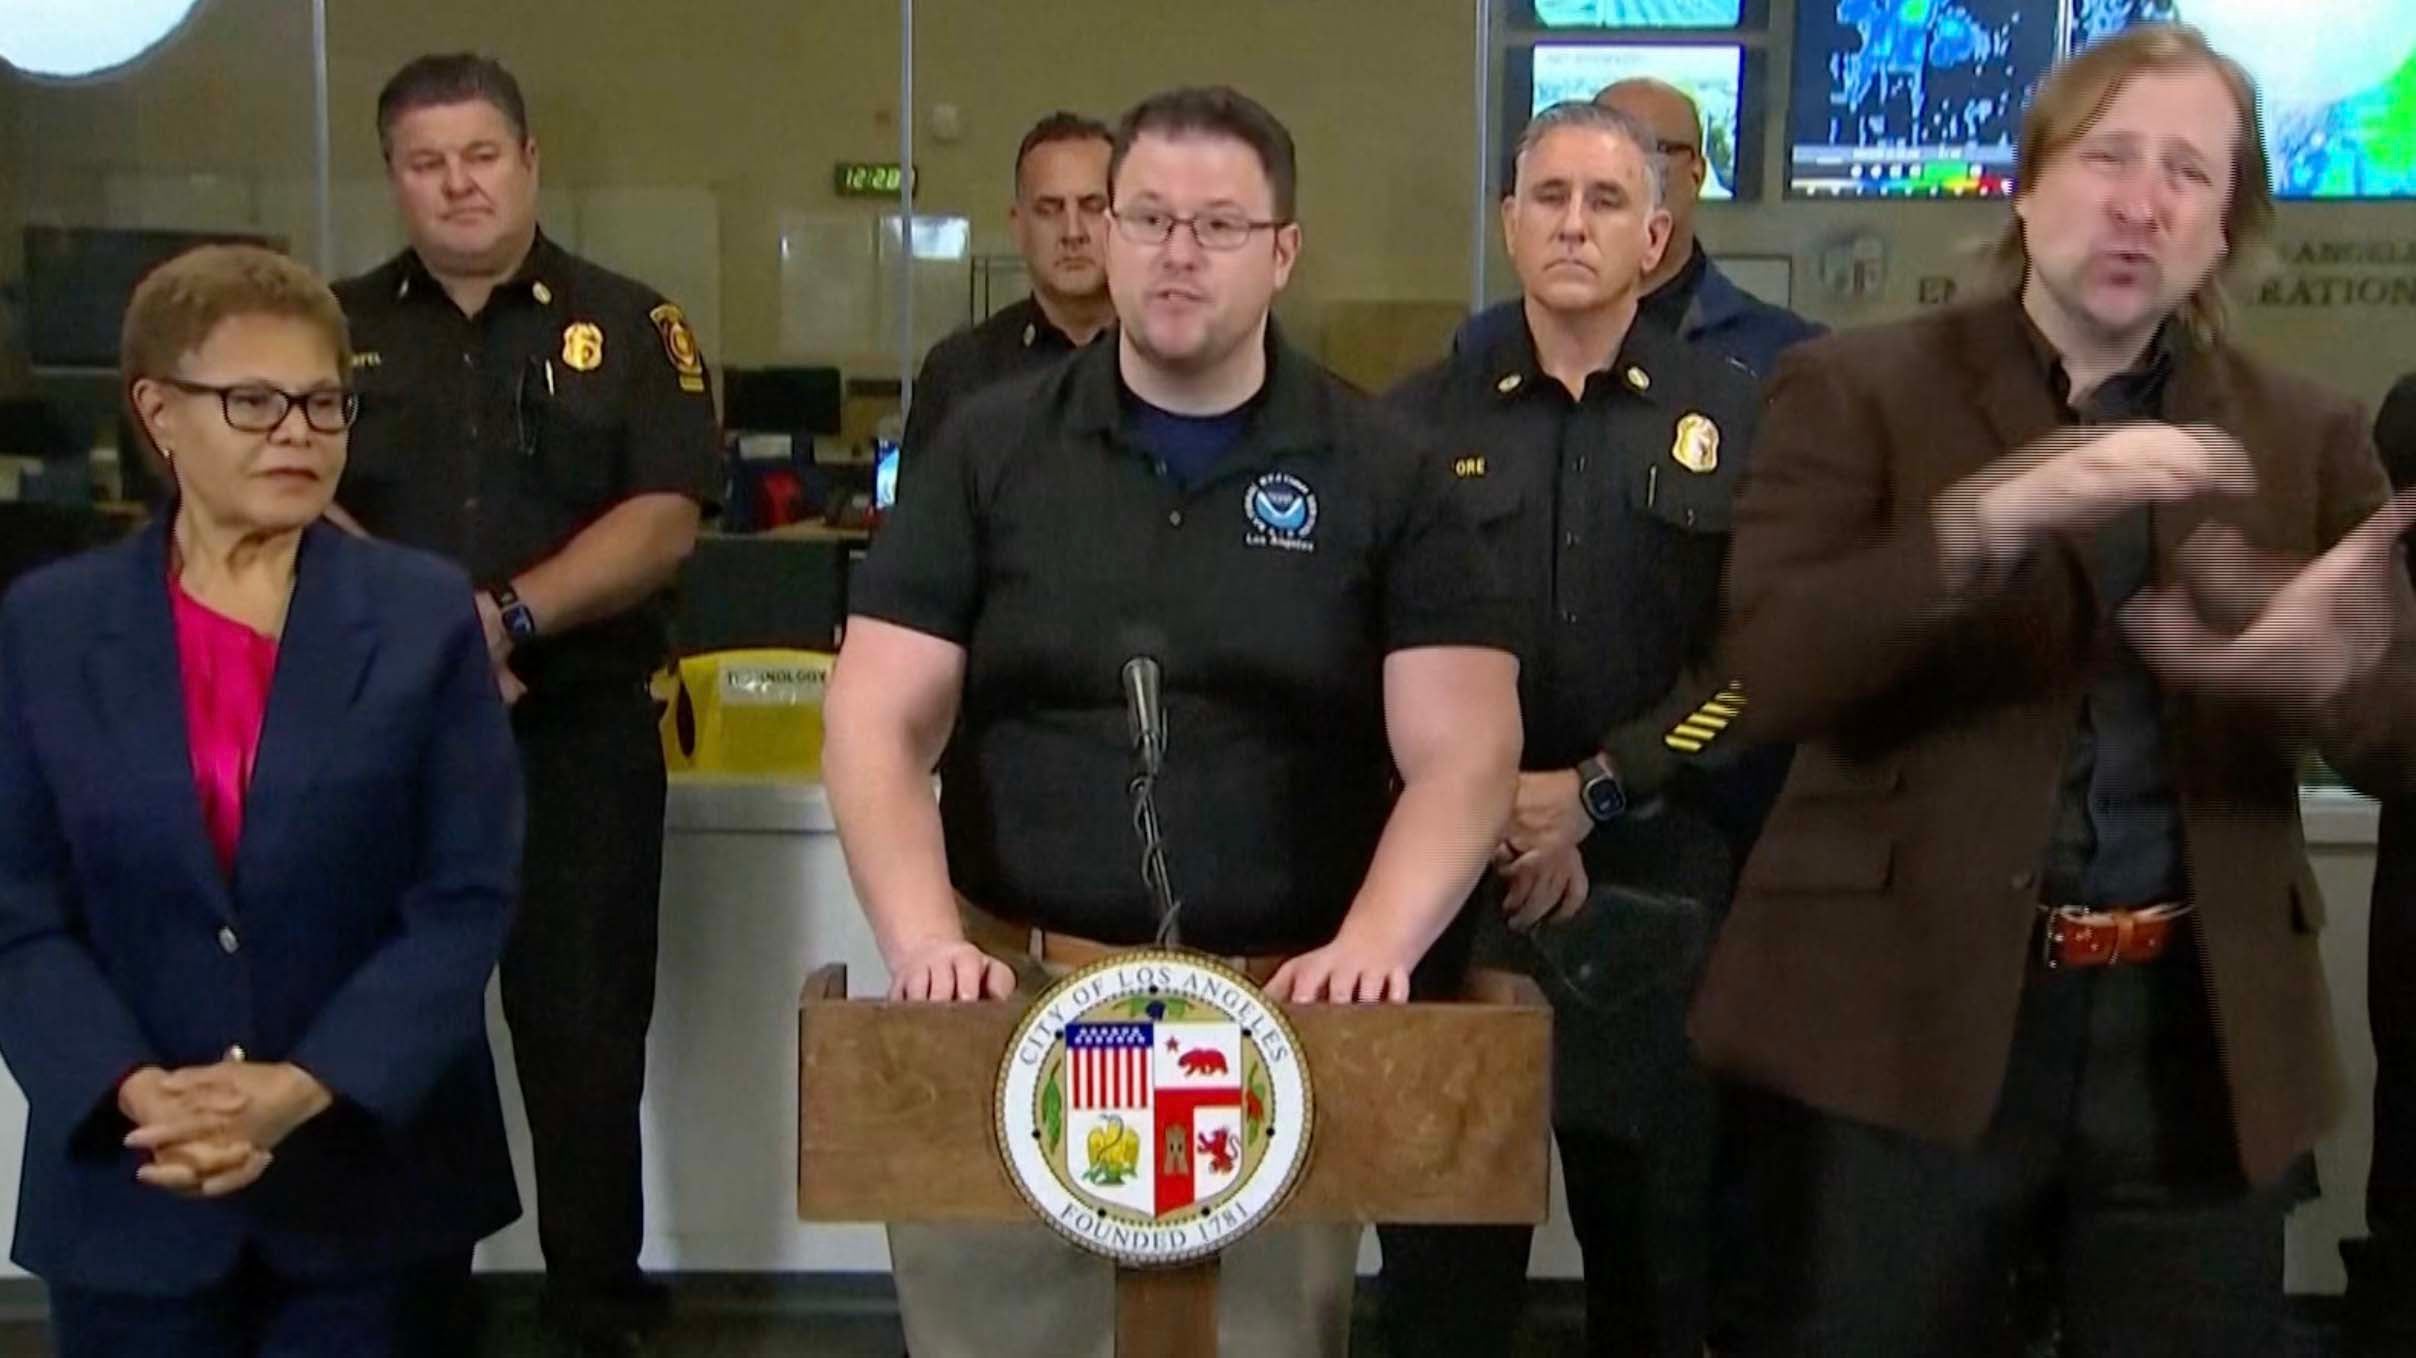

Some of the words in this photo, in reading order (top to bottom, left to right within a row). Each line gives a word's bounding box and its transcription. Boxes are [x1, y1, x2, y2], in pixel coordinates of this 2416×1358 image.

[1019, 1003, 1065, 1066] CITY
[1072, 978, 1105, 1006] OF
[1117, 966, 1171, 988] LOS
[1183, 971, 1289, 1063] ANGELES
[1061, 1203, 1187, 1249] FOUNDED
[1198, 1200, 1250, 1242] 1781
